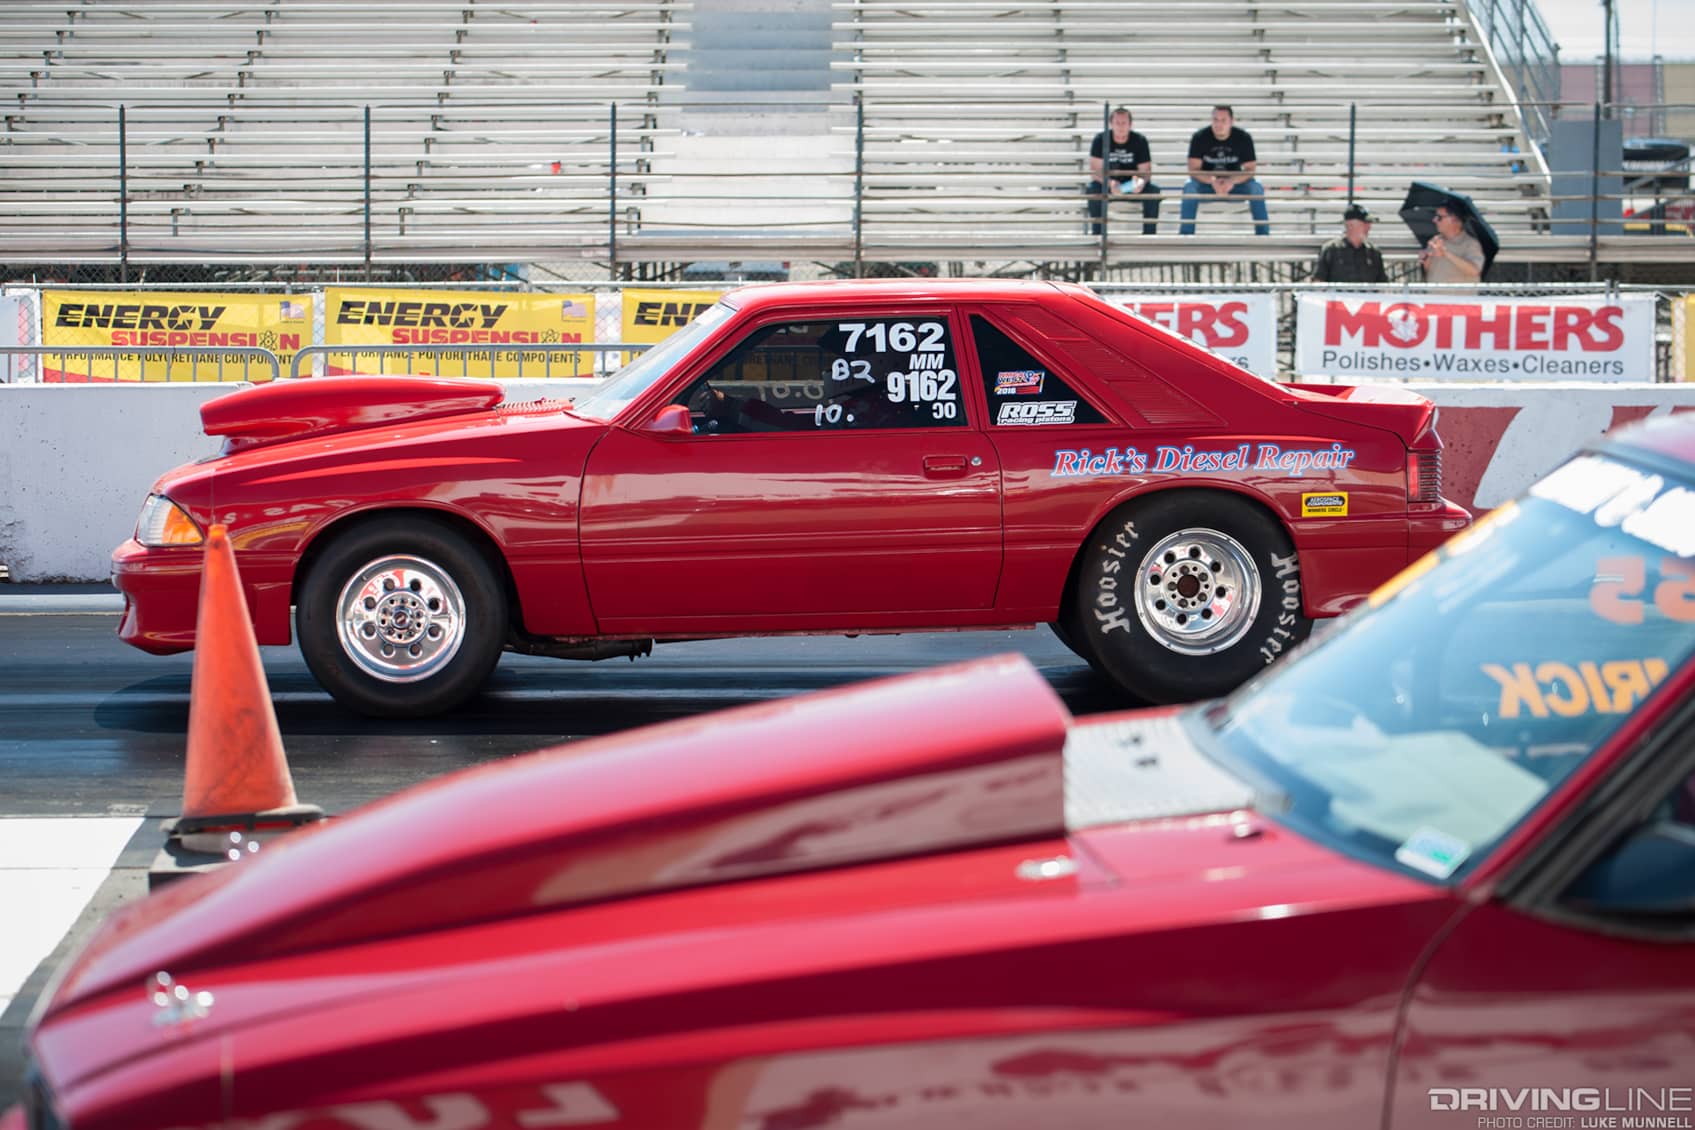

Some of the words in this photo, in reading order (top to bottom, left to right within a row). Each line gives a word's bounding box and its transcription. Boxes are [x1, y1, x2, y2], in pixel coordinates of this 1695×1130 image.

[55, 303, 227, 330] ENERGY
[336, 301, 509, 328] ENERGY
[1122, 302, 1249, 349] ERS
[1324, 300, 1624, 352] MOTHERS
[838, 322, 946, 353] 7162
[909, 353, 945, 370] MM
[887, 369, 957, 403] 9162
[1000, 403, 1074, 418] ROSS
[1153, 445, 1250, 473] Diesel
[1254, 442, 1356, 477] Repair
[1095, 521, 1139, 634] Hoosier
